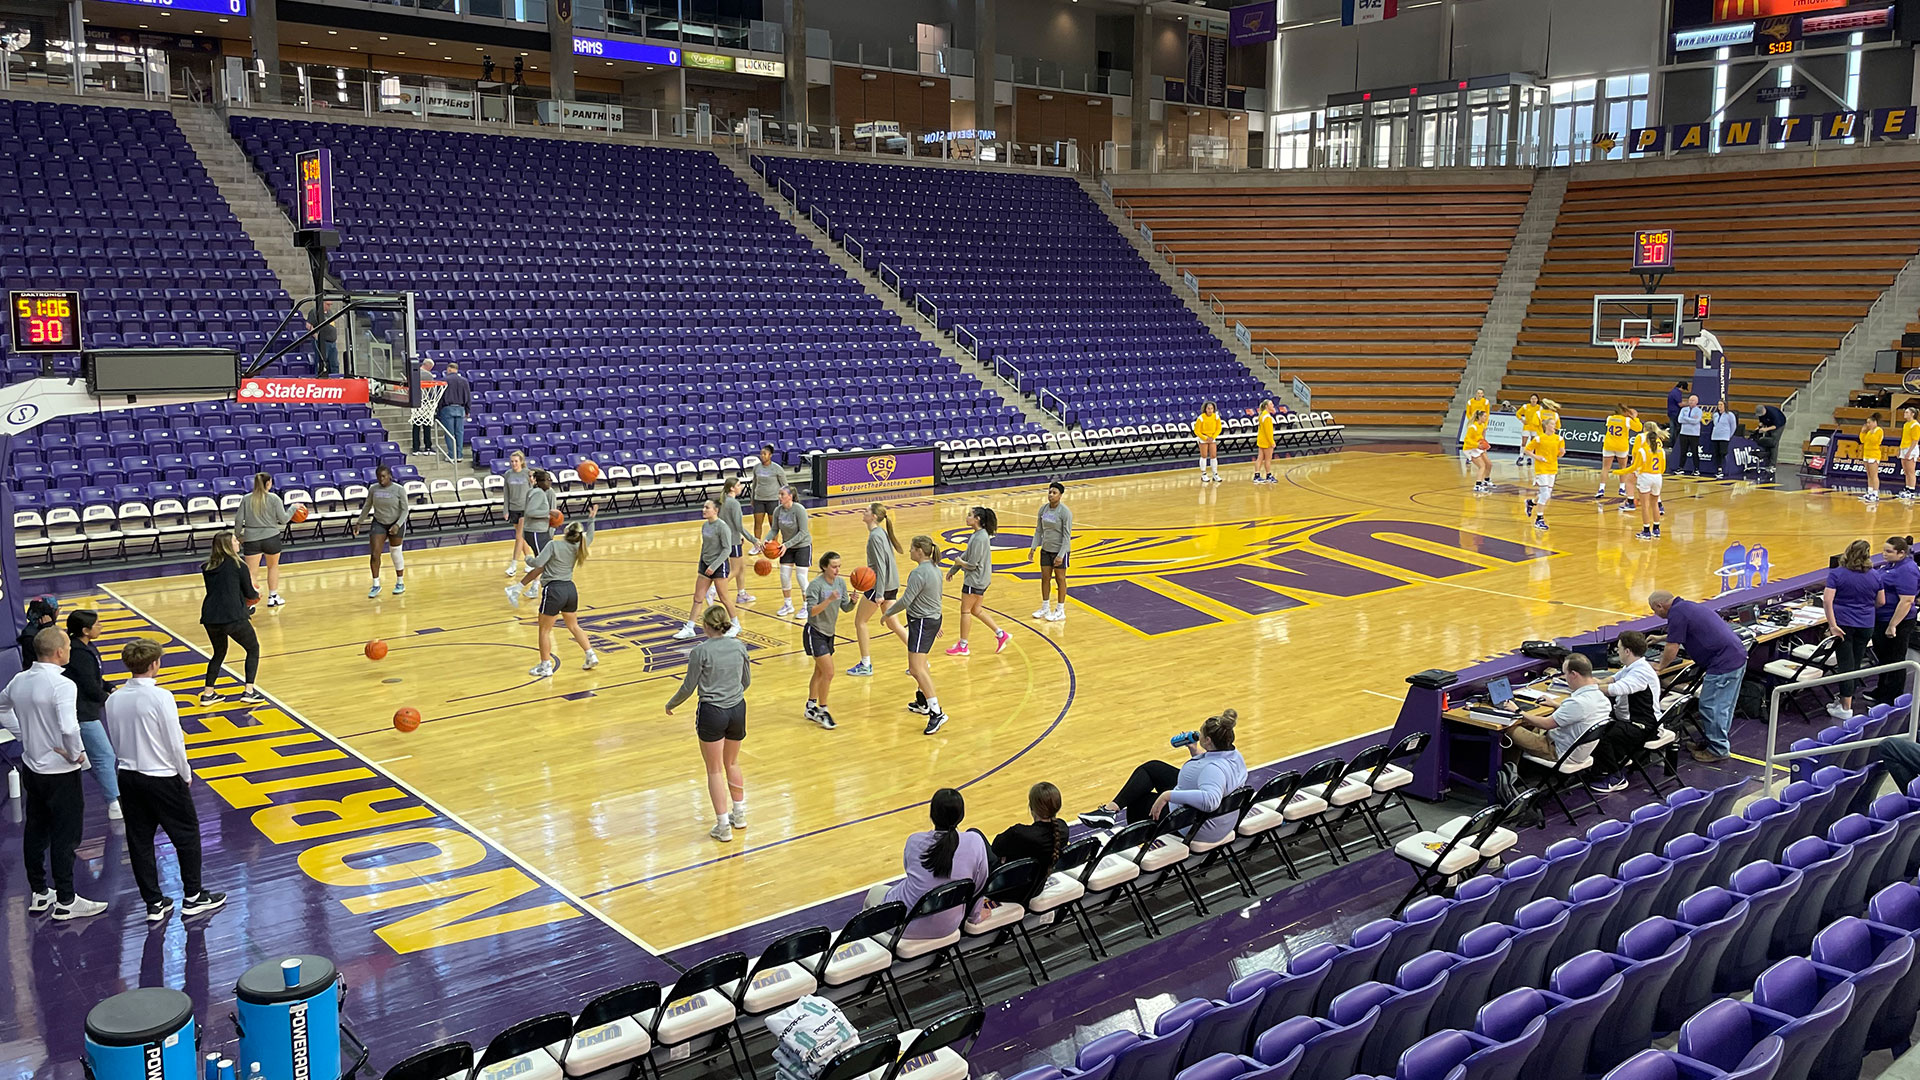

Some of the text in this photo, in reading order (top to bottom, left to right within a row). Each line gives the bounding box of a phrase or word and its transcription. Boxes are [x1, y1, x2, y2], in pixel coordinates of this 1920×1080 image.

[573, 38, 603, 55] RAMS
[1768, 40, 1793, 55] 5:03
[669, 50, 677, 64] 0
[691, 53, 725, 66] Veridian
[414, 95, 470, 109] PANTHERS
[1592, 131, 1619, 145] UNI
[1639, 232, 1668, 245] 51:06
[1642, 245, 1665, 263] 30
[18, 299, 71, 318] 51:06
[30, 319, 63, 343] 30
[1487, 419, 1506, 427] ilton
[870, 458, 894, 472] PSC
[1652, 457, 1660, 471] 2
[1064, 519, 1564, 637] UNI
[751, 967, 792, 991] UNI
[666, 994, 709, 1020] UNI
[292, 1004, 310, 1080] POWERAD
[575, 1023, 623, 1050] UNI
